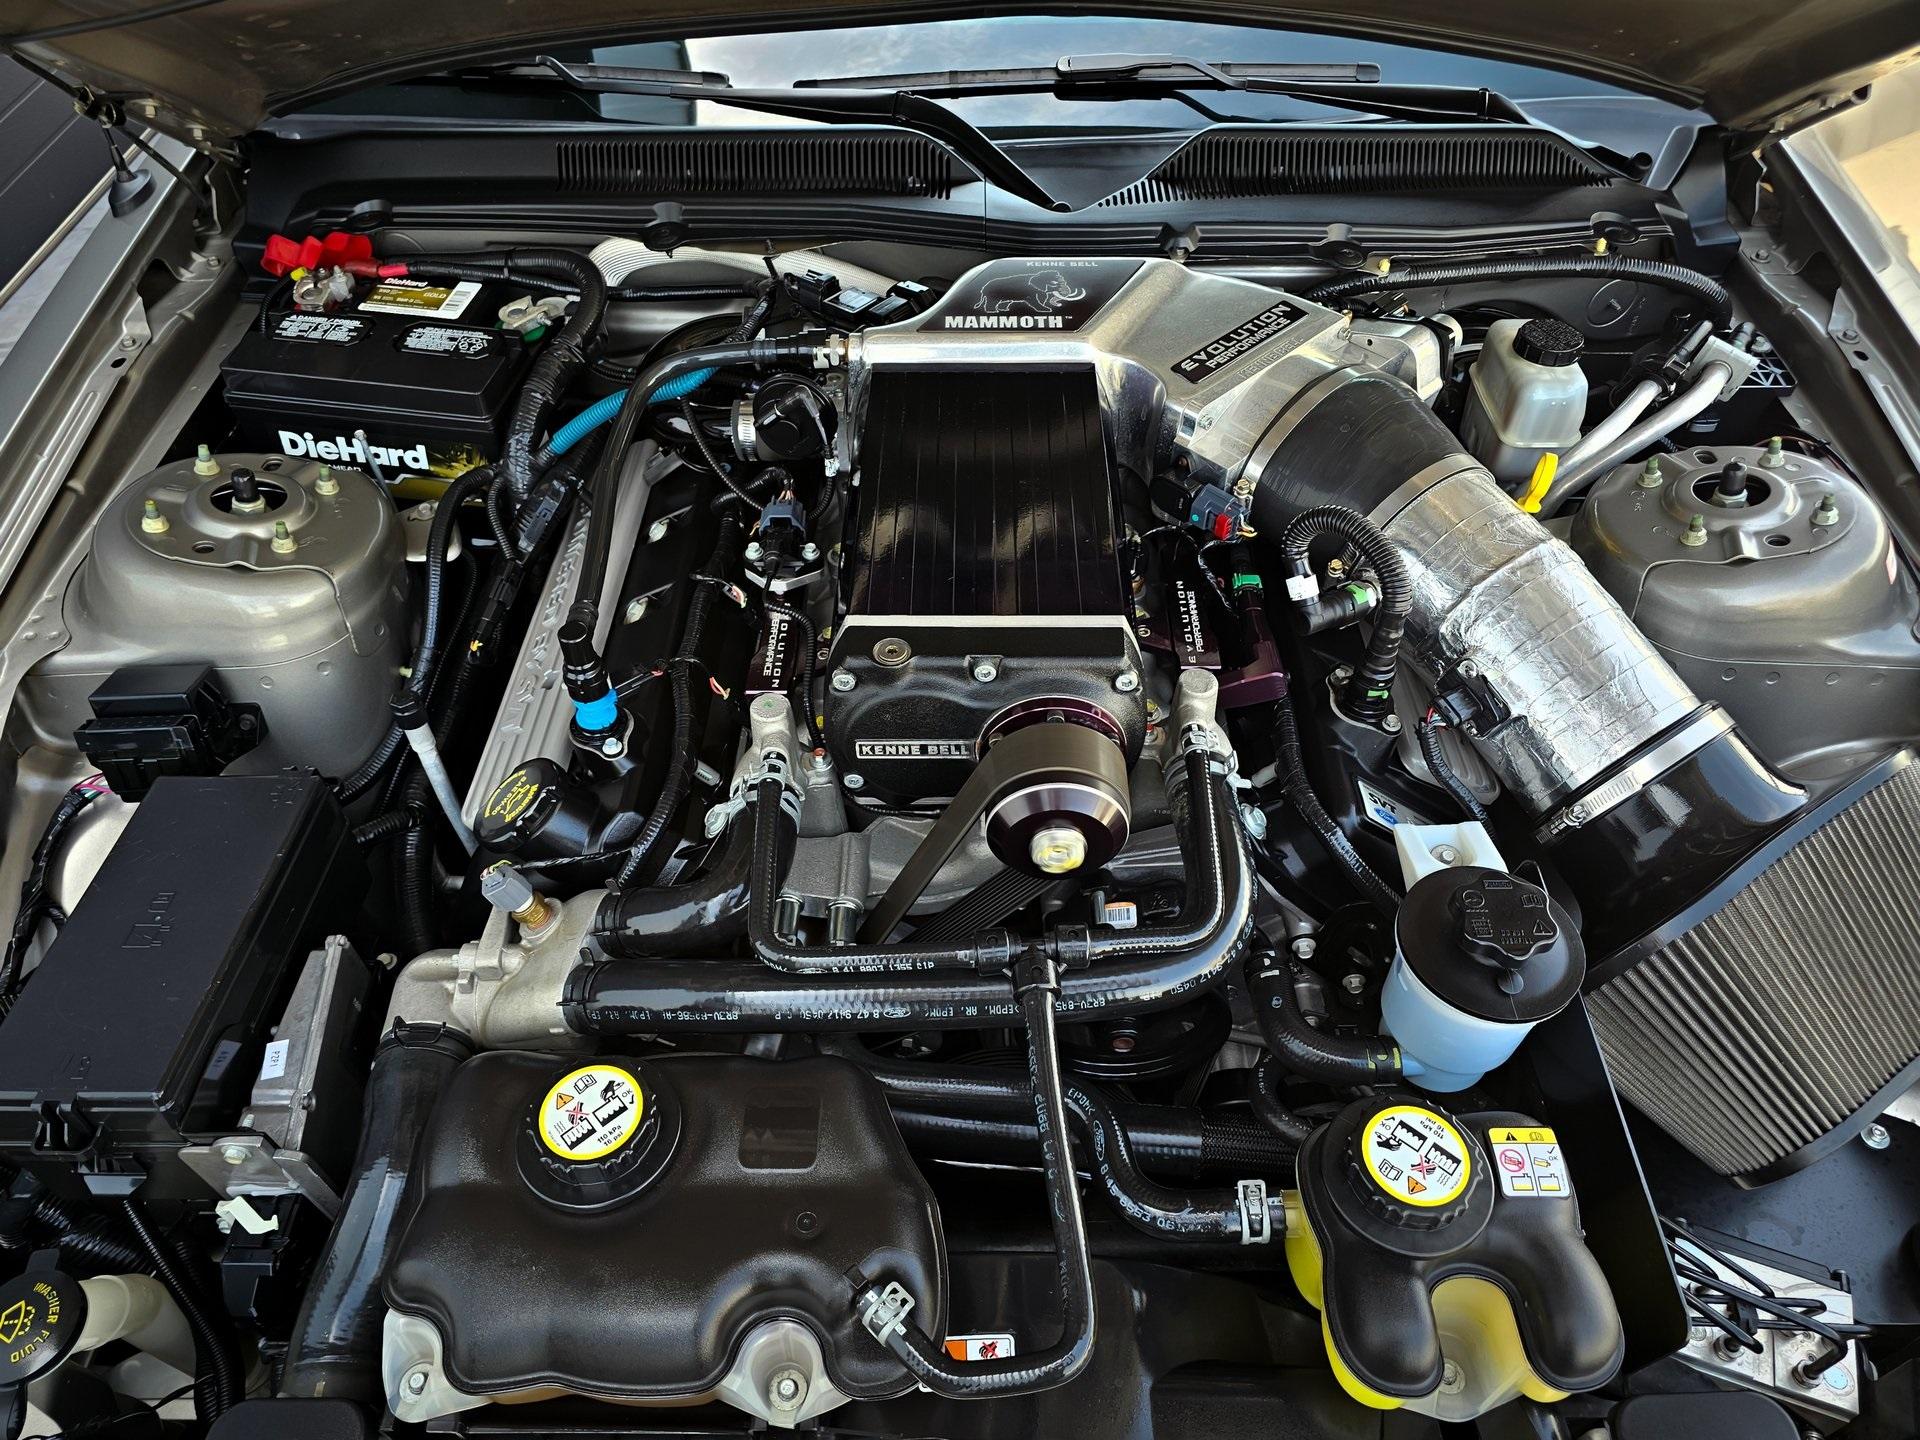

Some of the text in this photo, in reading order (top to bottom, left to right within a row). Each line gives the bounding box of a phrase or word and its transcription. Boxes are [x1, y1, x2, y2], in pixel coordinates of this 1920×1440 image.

[384, 277, 429, 288] DieHard
[944, 315, 1064, 329] MAMMOTH
[1179, 303, 1292, 372] EVOLUTION
[1205, 316, 1291, 369] PERFORMANCE
[277, 429, 430, 471] DieHard
[1175, 580, 1197, 664] EVOLUTION
[1186, 590, 1205, 653] PERFORMANCE
[861, 745, 970, 756] KENNE BELL
[1368, 792, 1397, 814] SVT
[621, 1087, 633, 1098] OK
[597, 1125, 622, 1143] 110 kPa
[1379, 1120, 1391, 1130] OK
[1419, 1120, 1444, 1139] 110 kPa
[603, 1131, 624, 1147] 16 psi
[10, 1282, 60, 1363] WASHER FLUID
